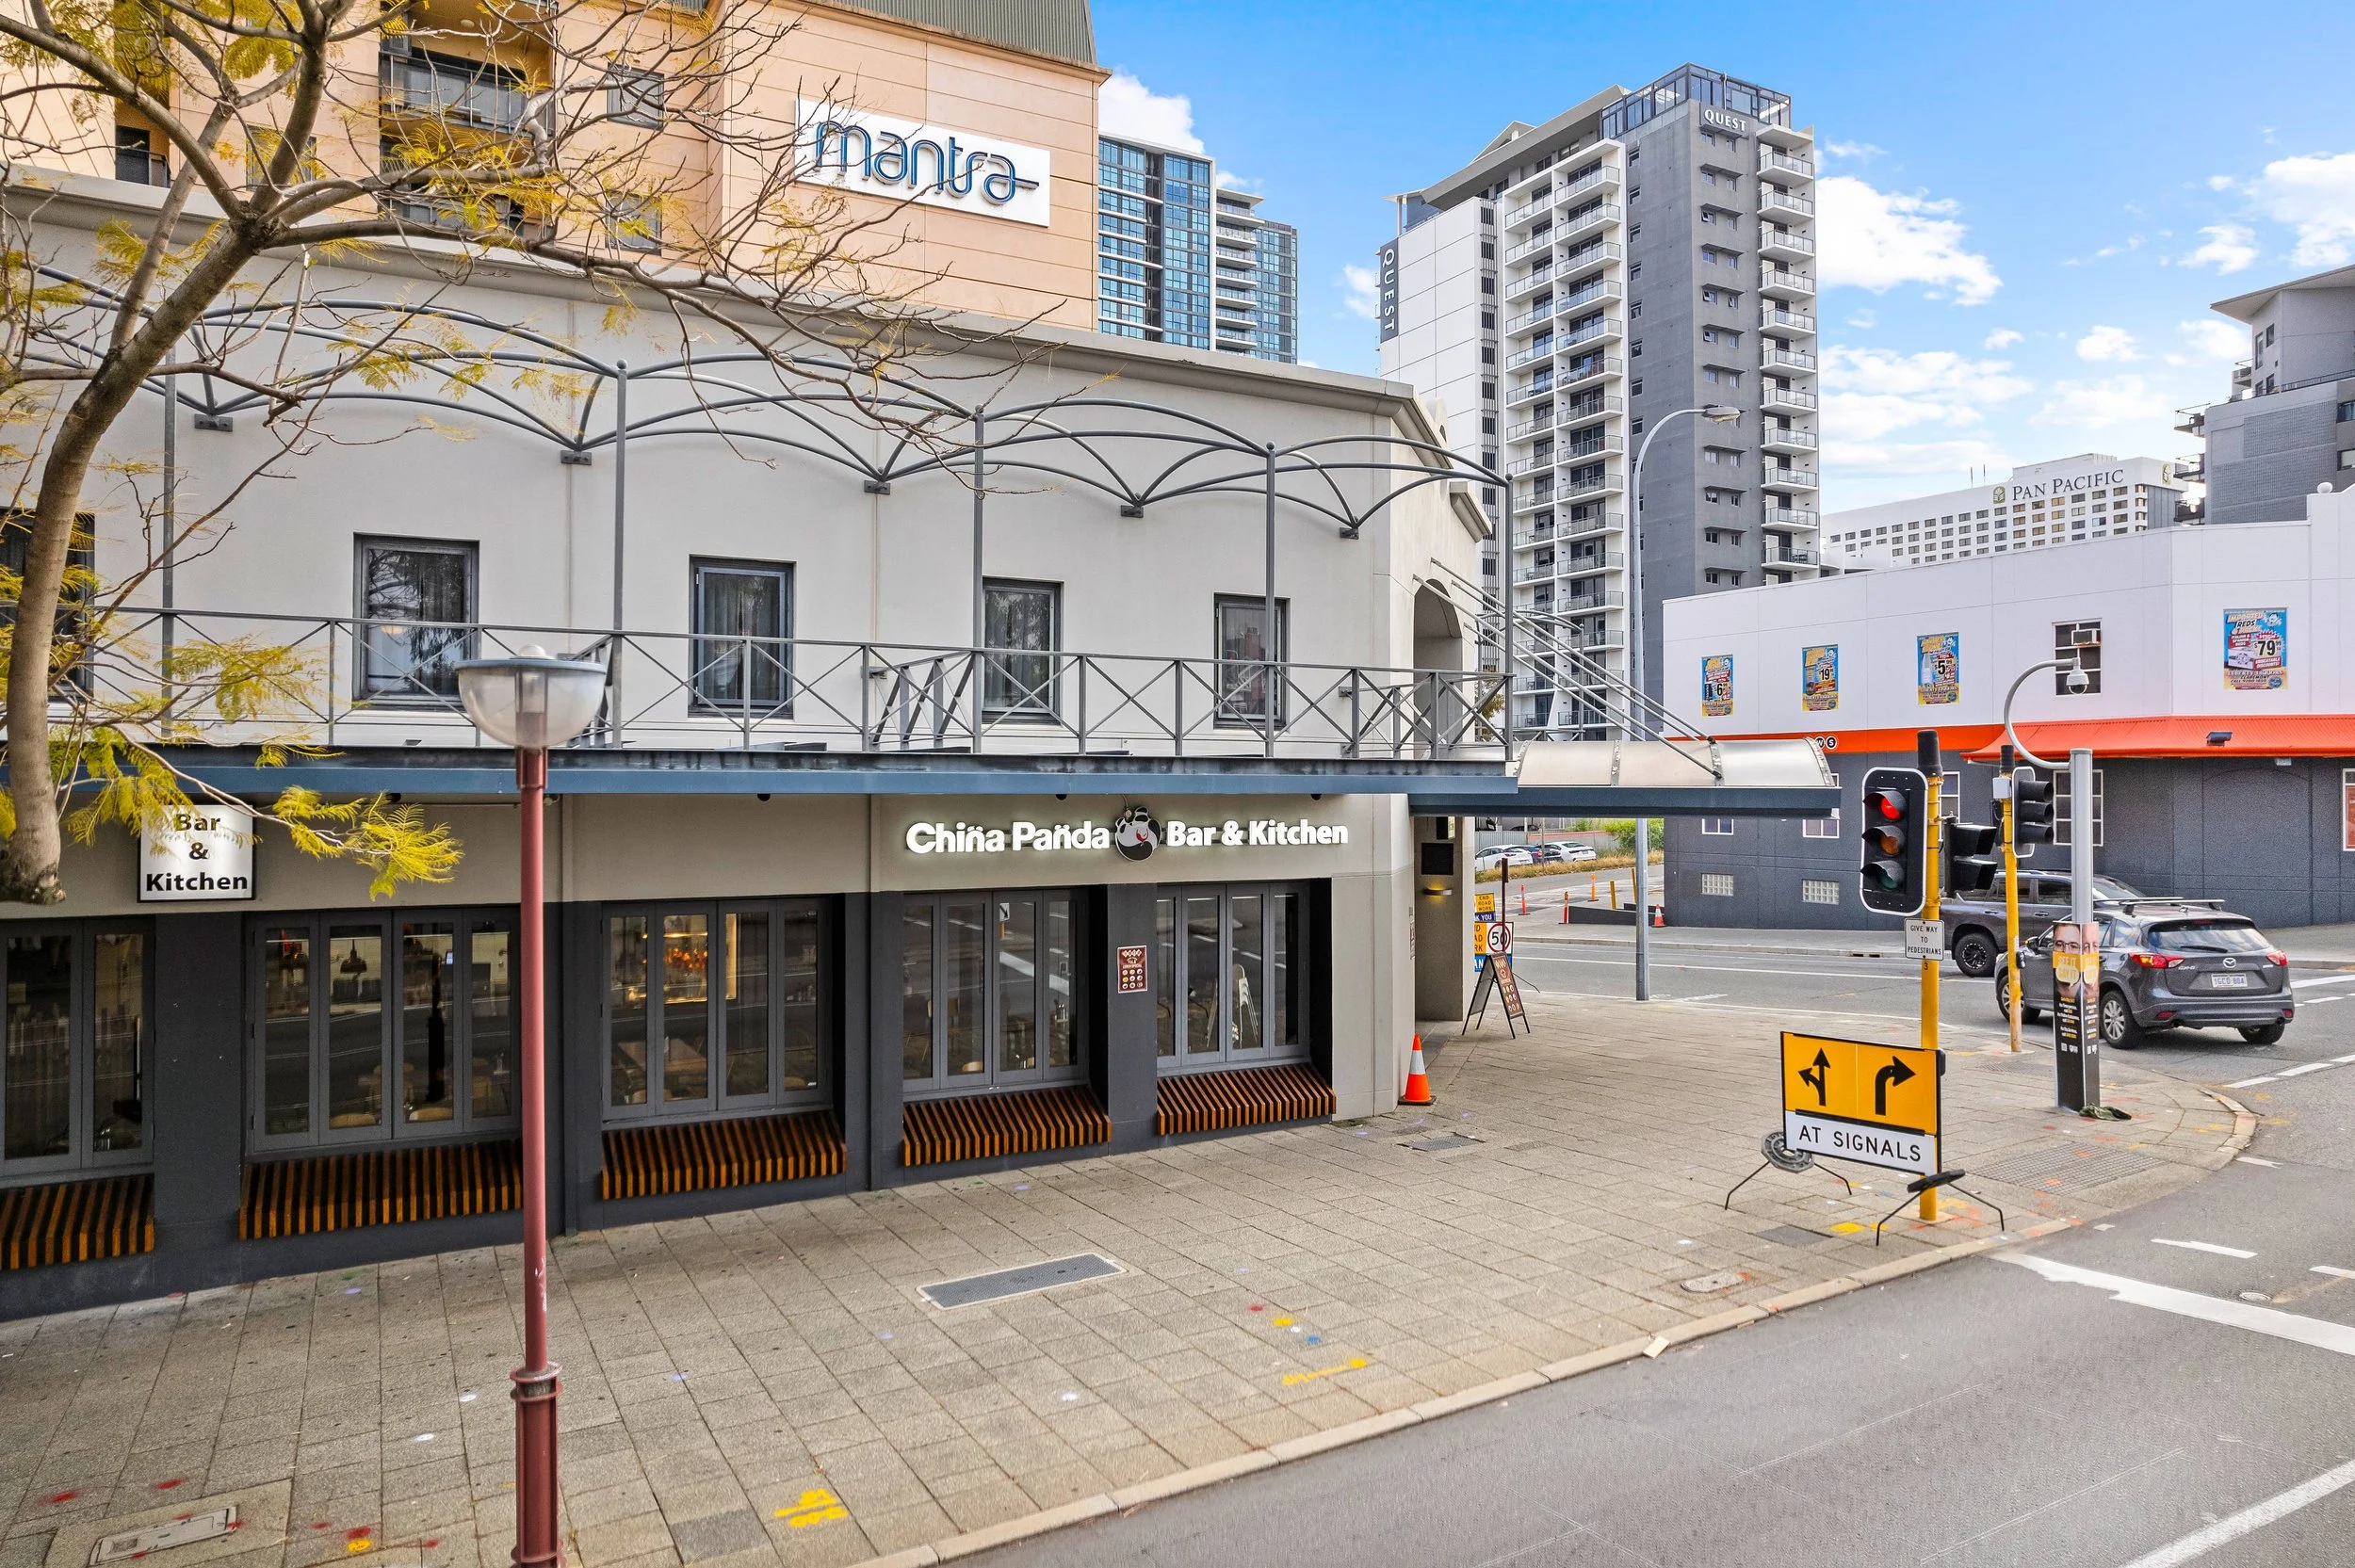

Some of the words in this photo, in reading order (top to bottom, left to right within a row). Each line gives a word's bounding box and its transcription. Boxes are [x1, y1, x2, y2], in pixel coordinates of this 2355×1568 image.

[1703, 108, 1747, 133] QUEST
[814, 120, 1040, 206] mantra
[1380, 247, 1397, 331] QUEST
[2012, 482, 2047, 501] PAN
[2052, 468, 2124, 494] PACIFIC
[173, 813, 221, 832] Bar
[1166, 820, 1217, 847] Bar
[1221, 820, 1244, 846] &
[1248, 818, 1349, 846] Kitchen
[188, 842, 209, 860] &
[146, 872, 248, 892] Kitchen
[1908, 946, 1941, 956] PEDESTRIANS
[1924, 962, 1929, 971] 3
[1798, 1124, 1822, 1143] AT
[1833, 1130, 1922, 1163] SIGNALS
